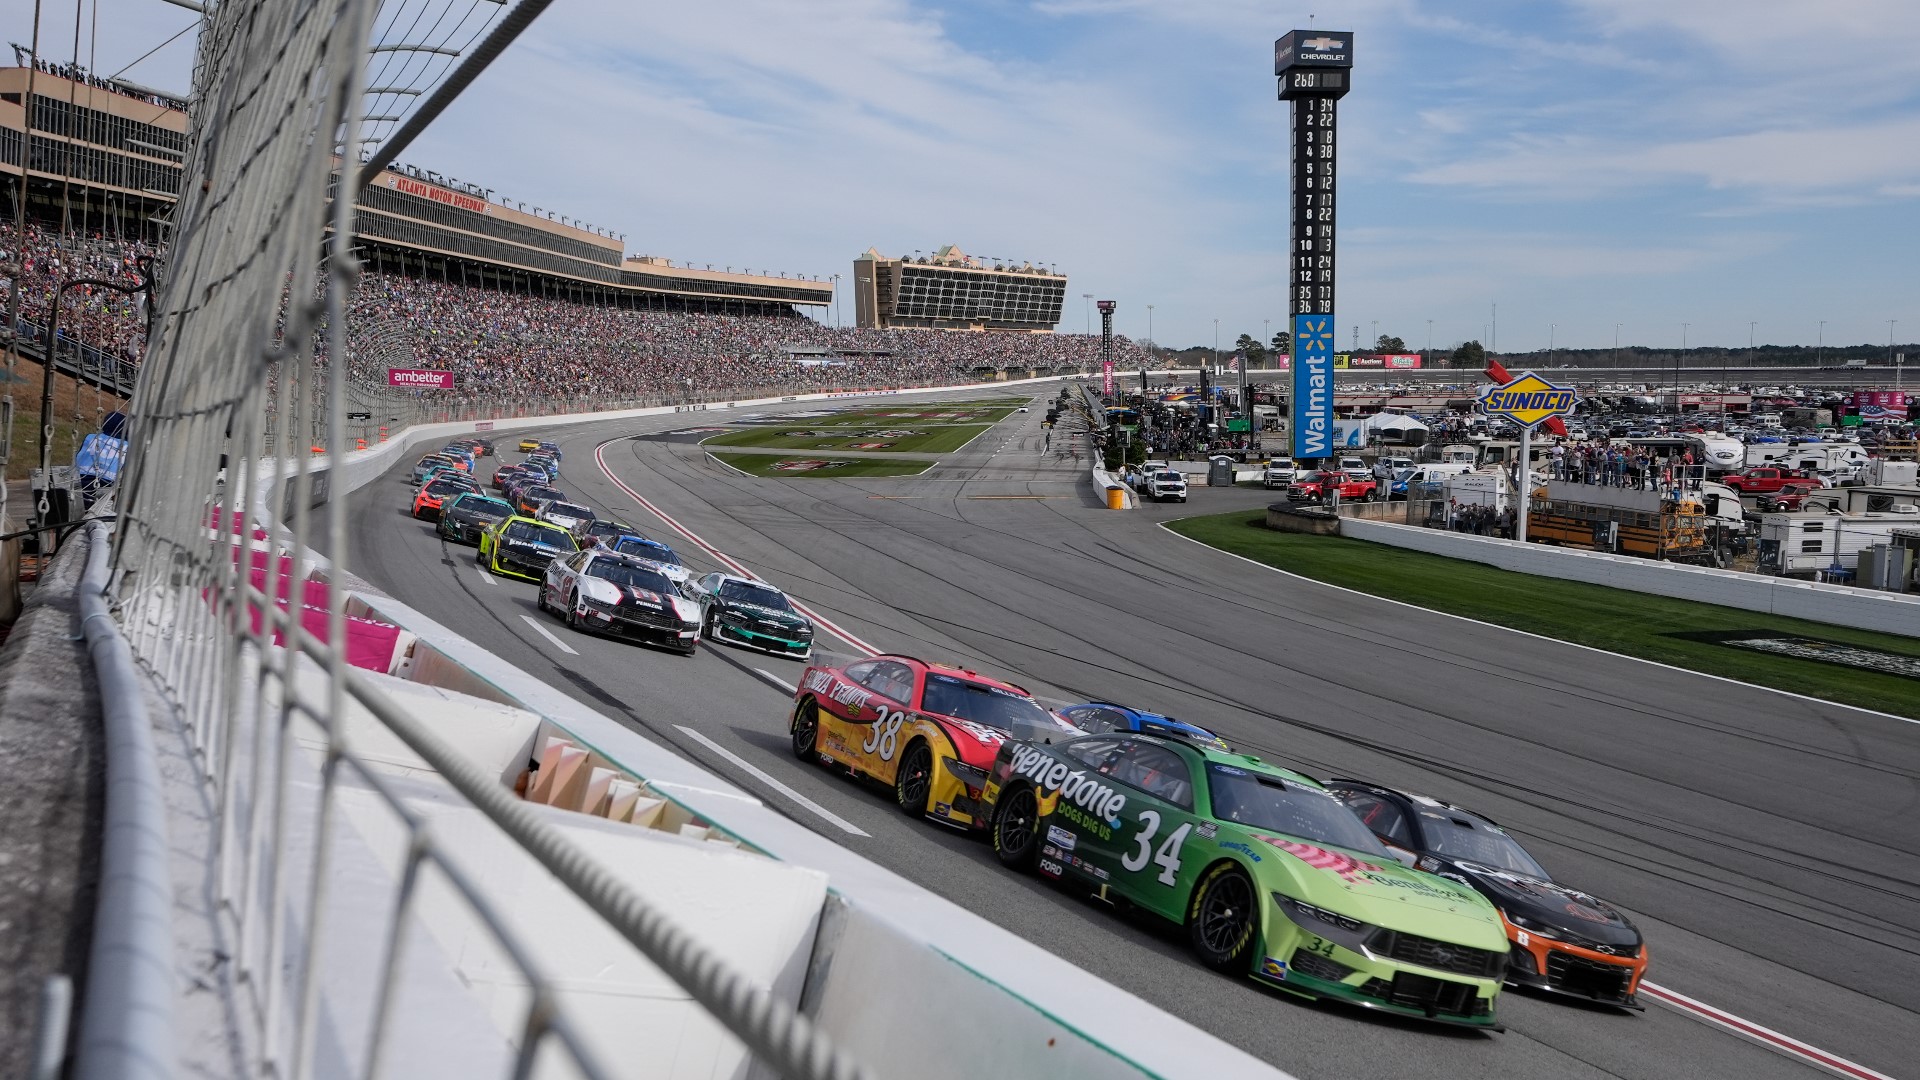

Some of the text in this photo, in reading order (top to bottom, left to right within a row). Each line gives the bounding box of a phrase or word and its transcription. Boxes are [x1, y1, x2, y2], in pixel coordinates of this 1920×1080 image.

[1301, 53, 1345, 61] CHEVROLET
[1295, 73, 1314, 87] 260
[1309, 99, 1333, 111] 1 34
[1306, 113, 1333, 126] 2 22
[1306, 131, 1333, 143] 3 8
[1306, 145, 1333, 158] 4 38
[1306, 162, 1332, 175] 5 5
[1306, 177, 1332, 189] 6 12
[396, 179, 486, 213] ATLANTA MOTOR SPEEDWAY
[1306, 194, 1332, 208] 7 17
[1306, 209, 1312, 219] 8
[1306, 225, 1331, 237] 9 14
[1301, 239, 1331, 251] 10 3
[1301, 256, 1331, 268] 11 24
[1301, 270, 1331, 281] 12 19
[1300, 286, 1311, 299] 35
[1300, 300, 1330, 313] 36 78
[394, 371, 444, 383] ambetter
[1305, 356, 1326, 454] Walmart
[1488, 392, 1573, 409] SUNOCO
[636, 600, 664, 611] PENNZOIL
[590, 608, 600, 617] 12
[863, 704, 905, 761] 38
[821, 752, 834, 764] FORD
[1010, 743, 1126, 823] Benebone
[1058, 801, 1111, 841] DOGS DIG US
[1121, 810, 1194, 888] 34
[1040, 859, 1063, 875] FORD
[1517, 930, 1530, 947] 8
[1307, 937, 1335, 957] 34
